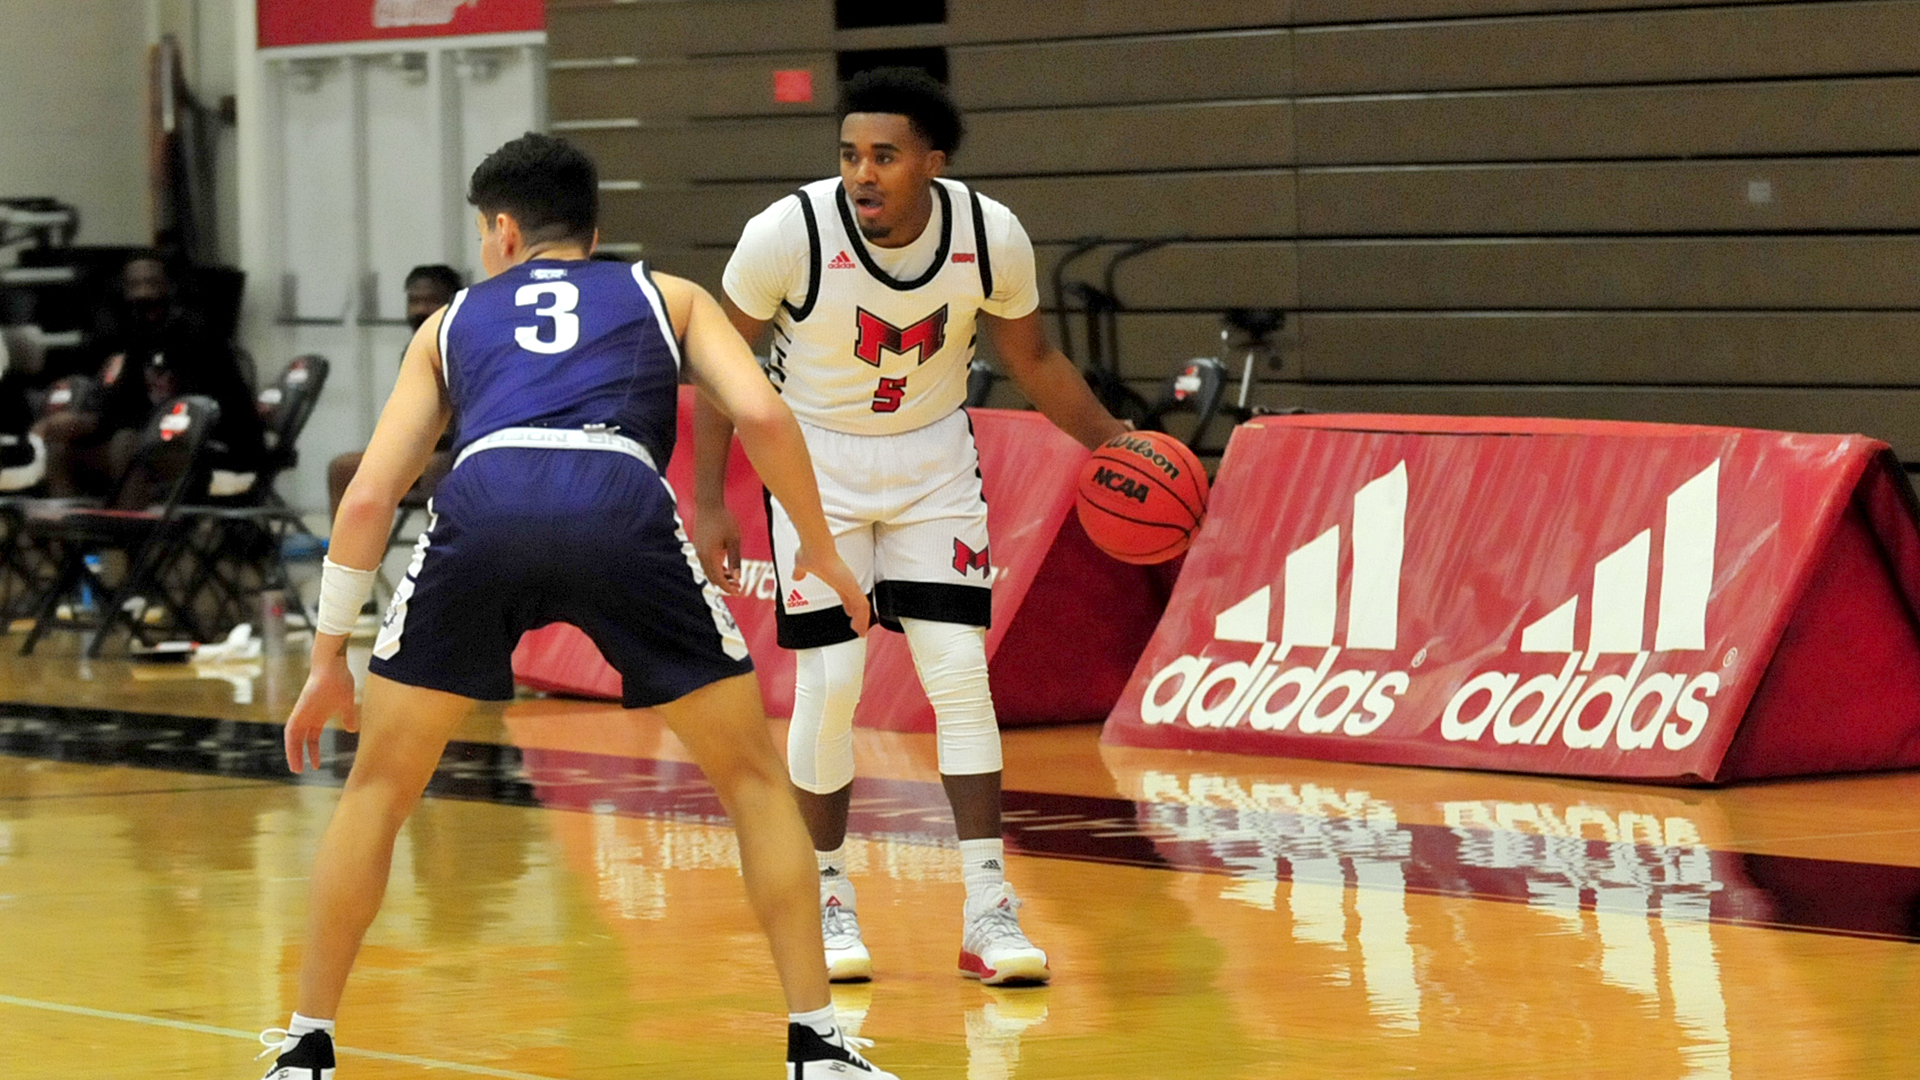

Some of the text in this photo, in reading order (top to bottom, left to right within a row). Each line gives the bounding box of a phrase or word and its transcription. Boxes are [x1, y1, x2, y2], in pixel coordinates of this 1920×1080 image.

[514, 281, 580, 354] 3
[854, 302, 948, 368] M
[871, 376, 907, 413] 5
[1092, 466, 1150, 504] NCAA
[1105, 436, 1180, 480] Wilson
[952, 536, 991, 580] M
[1141, 642, 1410, 736] adidas
[1440, 650, 1720, 751] adidas
